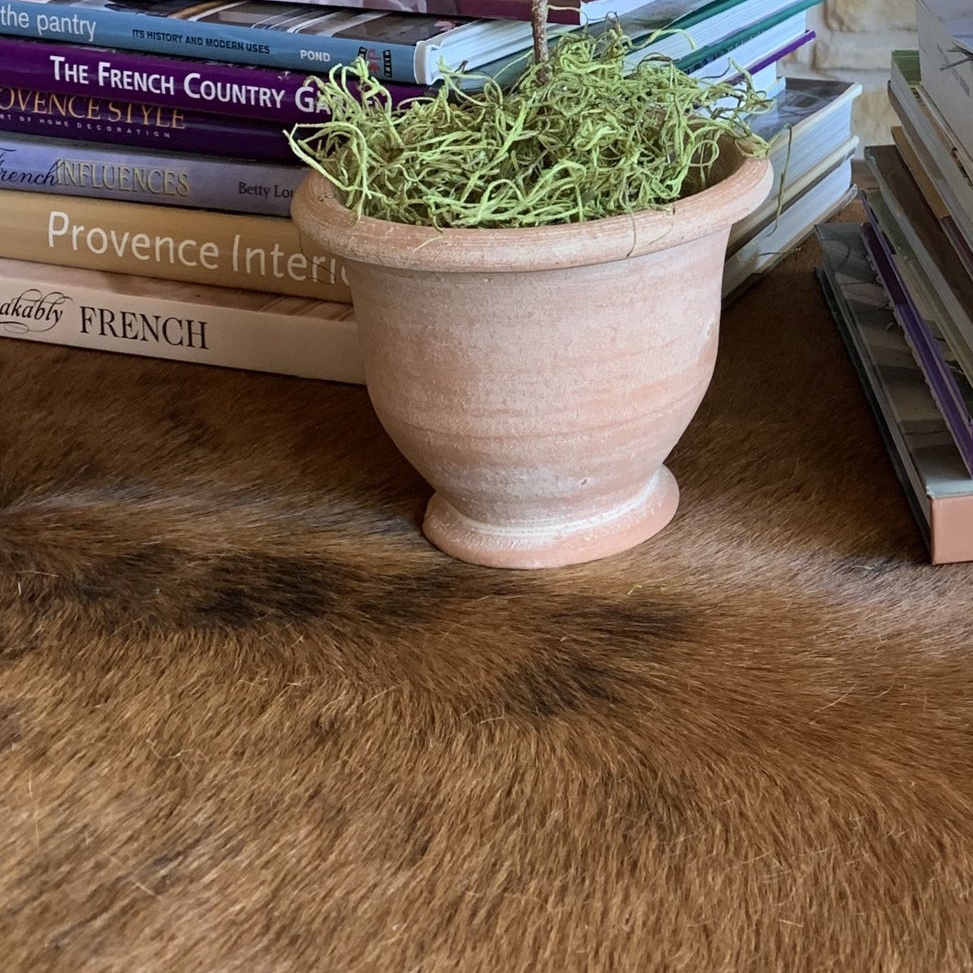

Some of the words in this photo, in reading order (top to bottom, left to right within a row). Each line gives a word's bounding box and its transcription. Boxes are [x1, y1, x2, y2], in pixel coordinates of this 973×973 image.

[0, 4, 29, 29] the
[36, 14, 97, 42] pantry
[132, 29, 145, 39] ITS
[147, 31, 183, 44] HISTORY
[185, 35, 204, 46] AND
[205, 38, 244, 50] MODERN
[245, 42, 271, 55] USES
[300, 49, 331, 62] POND
[50, 55, 89, 85] THE
[98, 61, 175, 97] FRENCH
[183, 72, 286, 114] COUNTRY
[19, 115, 31, 123] OF
[39, 118, 70, 128] HOME
[77, 122, 171, 139] DECORATION
[108, 102, 187, 130] STYLE
[55, 159, 192, 197] INFLUENCES
[237, 181, 272, 200] Betty
[47, 210, 219, 271] Provence
[232, 234, 350, 286] Interi
[79, 305, 210, 350] FRENCH
